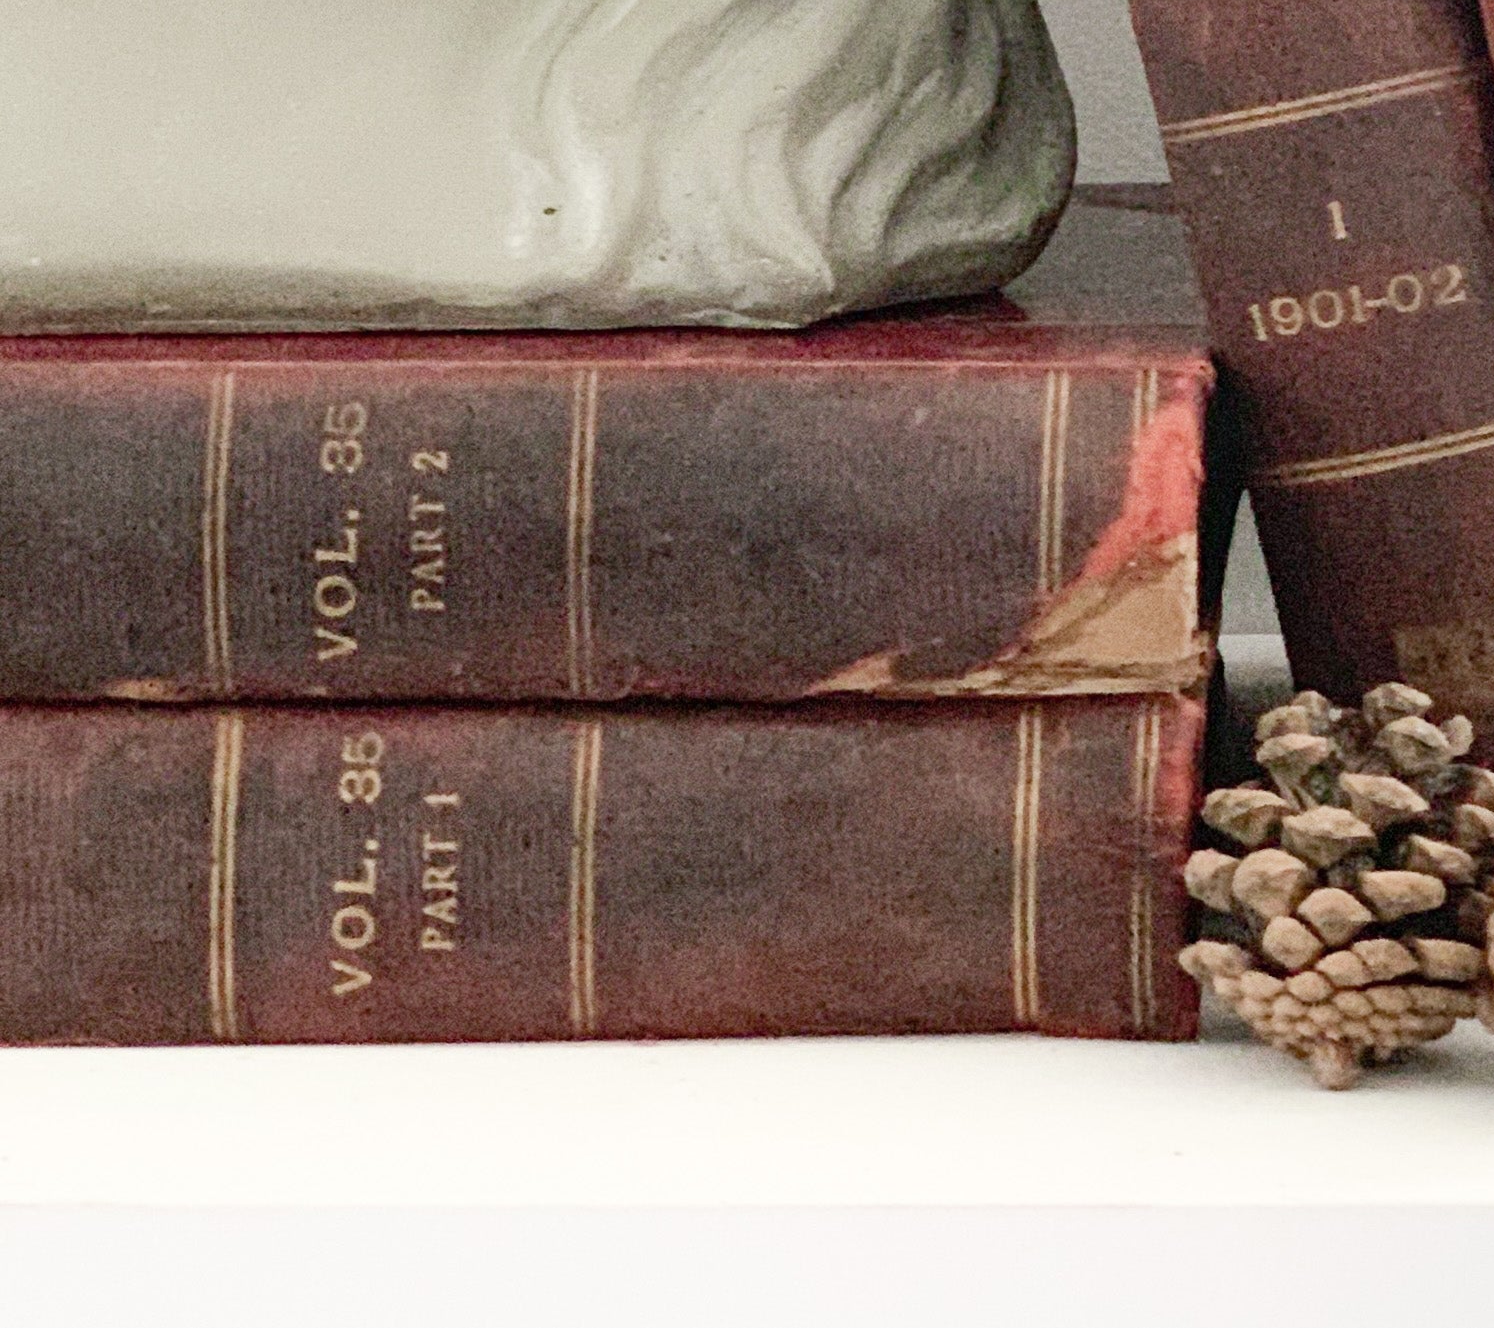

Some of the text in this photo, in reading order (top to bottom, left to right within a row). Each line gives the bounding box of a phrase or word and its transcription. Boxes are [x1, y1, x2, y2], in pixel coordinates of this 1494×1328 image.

[1326, 200, 1348, 240] 1
[1248, 263, 1468, 342] 1901-02
[313, 401, 369, 663] VOL. 35
[409, 450, 449, 612] PART 2
[329, 731, 386, 998] VOL. 35
[420, 792, 462, 953] PART 1
